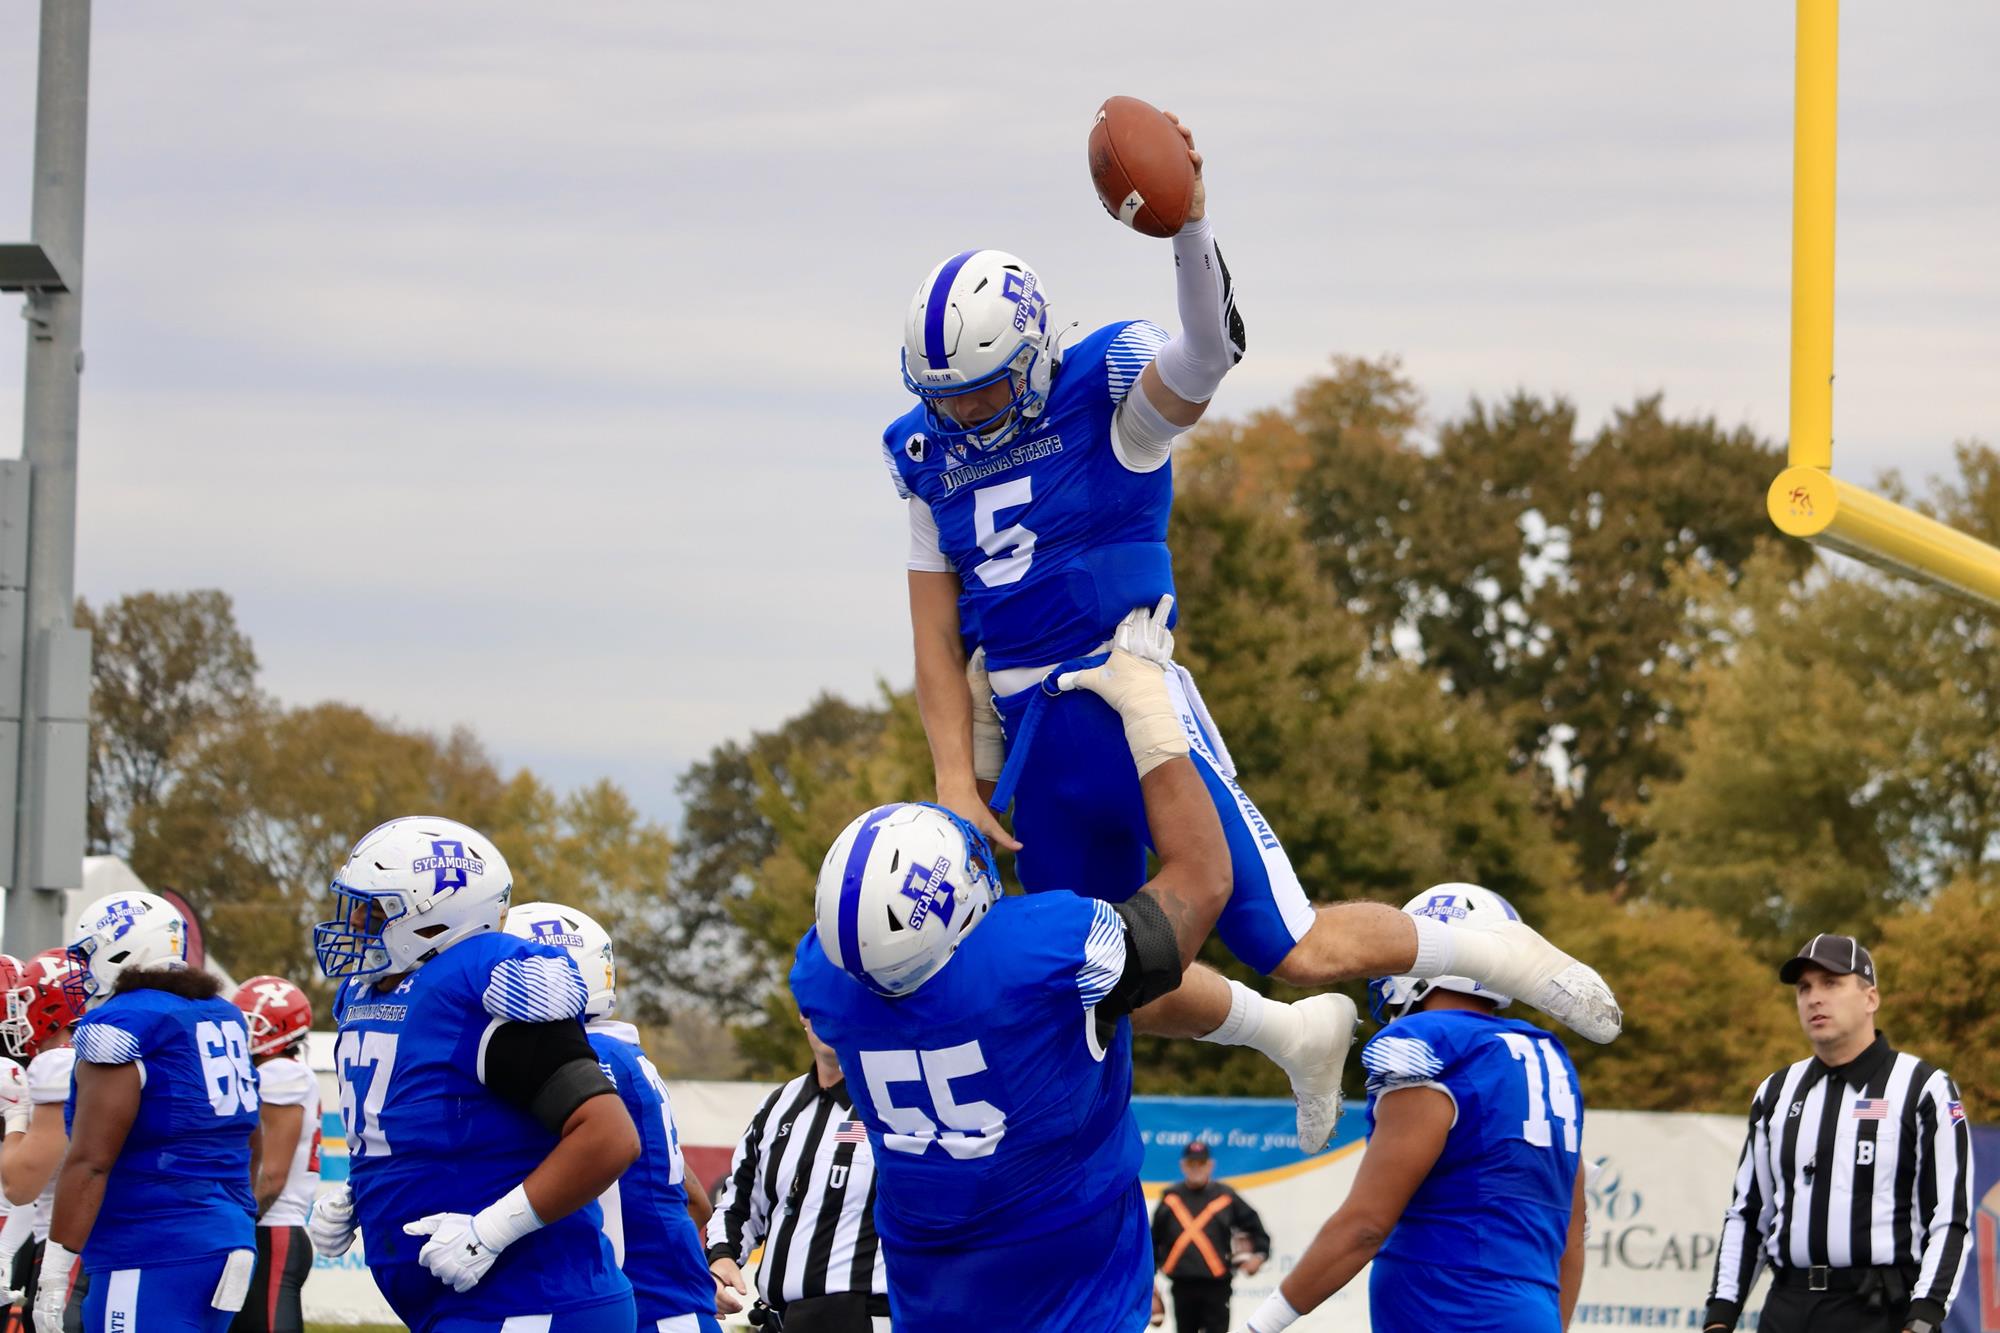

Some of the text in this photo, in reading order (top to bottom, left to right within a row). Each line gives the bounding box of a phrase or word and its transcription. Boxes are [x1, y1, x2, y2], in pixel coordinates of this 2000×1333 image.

[1014, 272, 1037, 332] SYCAMORES
[926, 373, 952, 382] ALL IN
[940, 434, 1063, 497] INDIANA STATE
[974, 475, 1038, 588] 5
[414, 857, 482, 874] SYCAMORES
[910, 857, 950, 930] SYCAMORES
[97, 907, 144, 929] SYCAMORES
[528, 933, 583, 947] CAMORES
[376, 1004, 407, 1021] STATE
[337, 1030, 399, 1157] 67
[859, 1039, 1008, 1160] 55
[1494, 1032, 1578, 1153] 74
[1155, 1130, 1189, 1145] can
[1196, 1127, 1223, 1146] do
[1227, 1128, 1258, 1147] for
[1260, 1133, 1298, 1152] you
[1856, 1140, 1875, 1166] B
[829, 1165, 849, 1189] U
